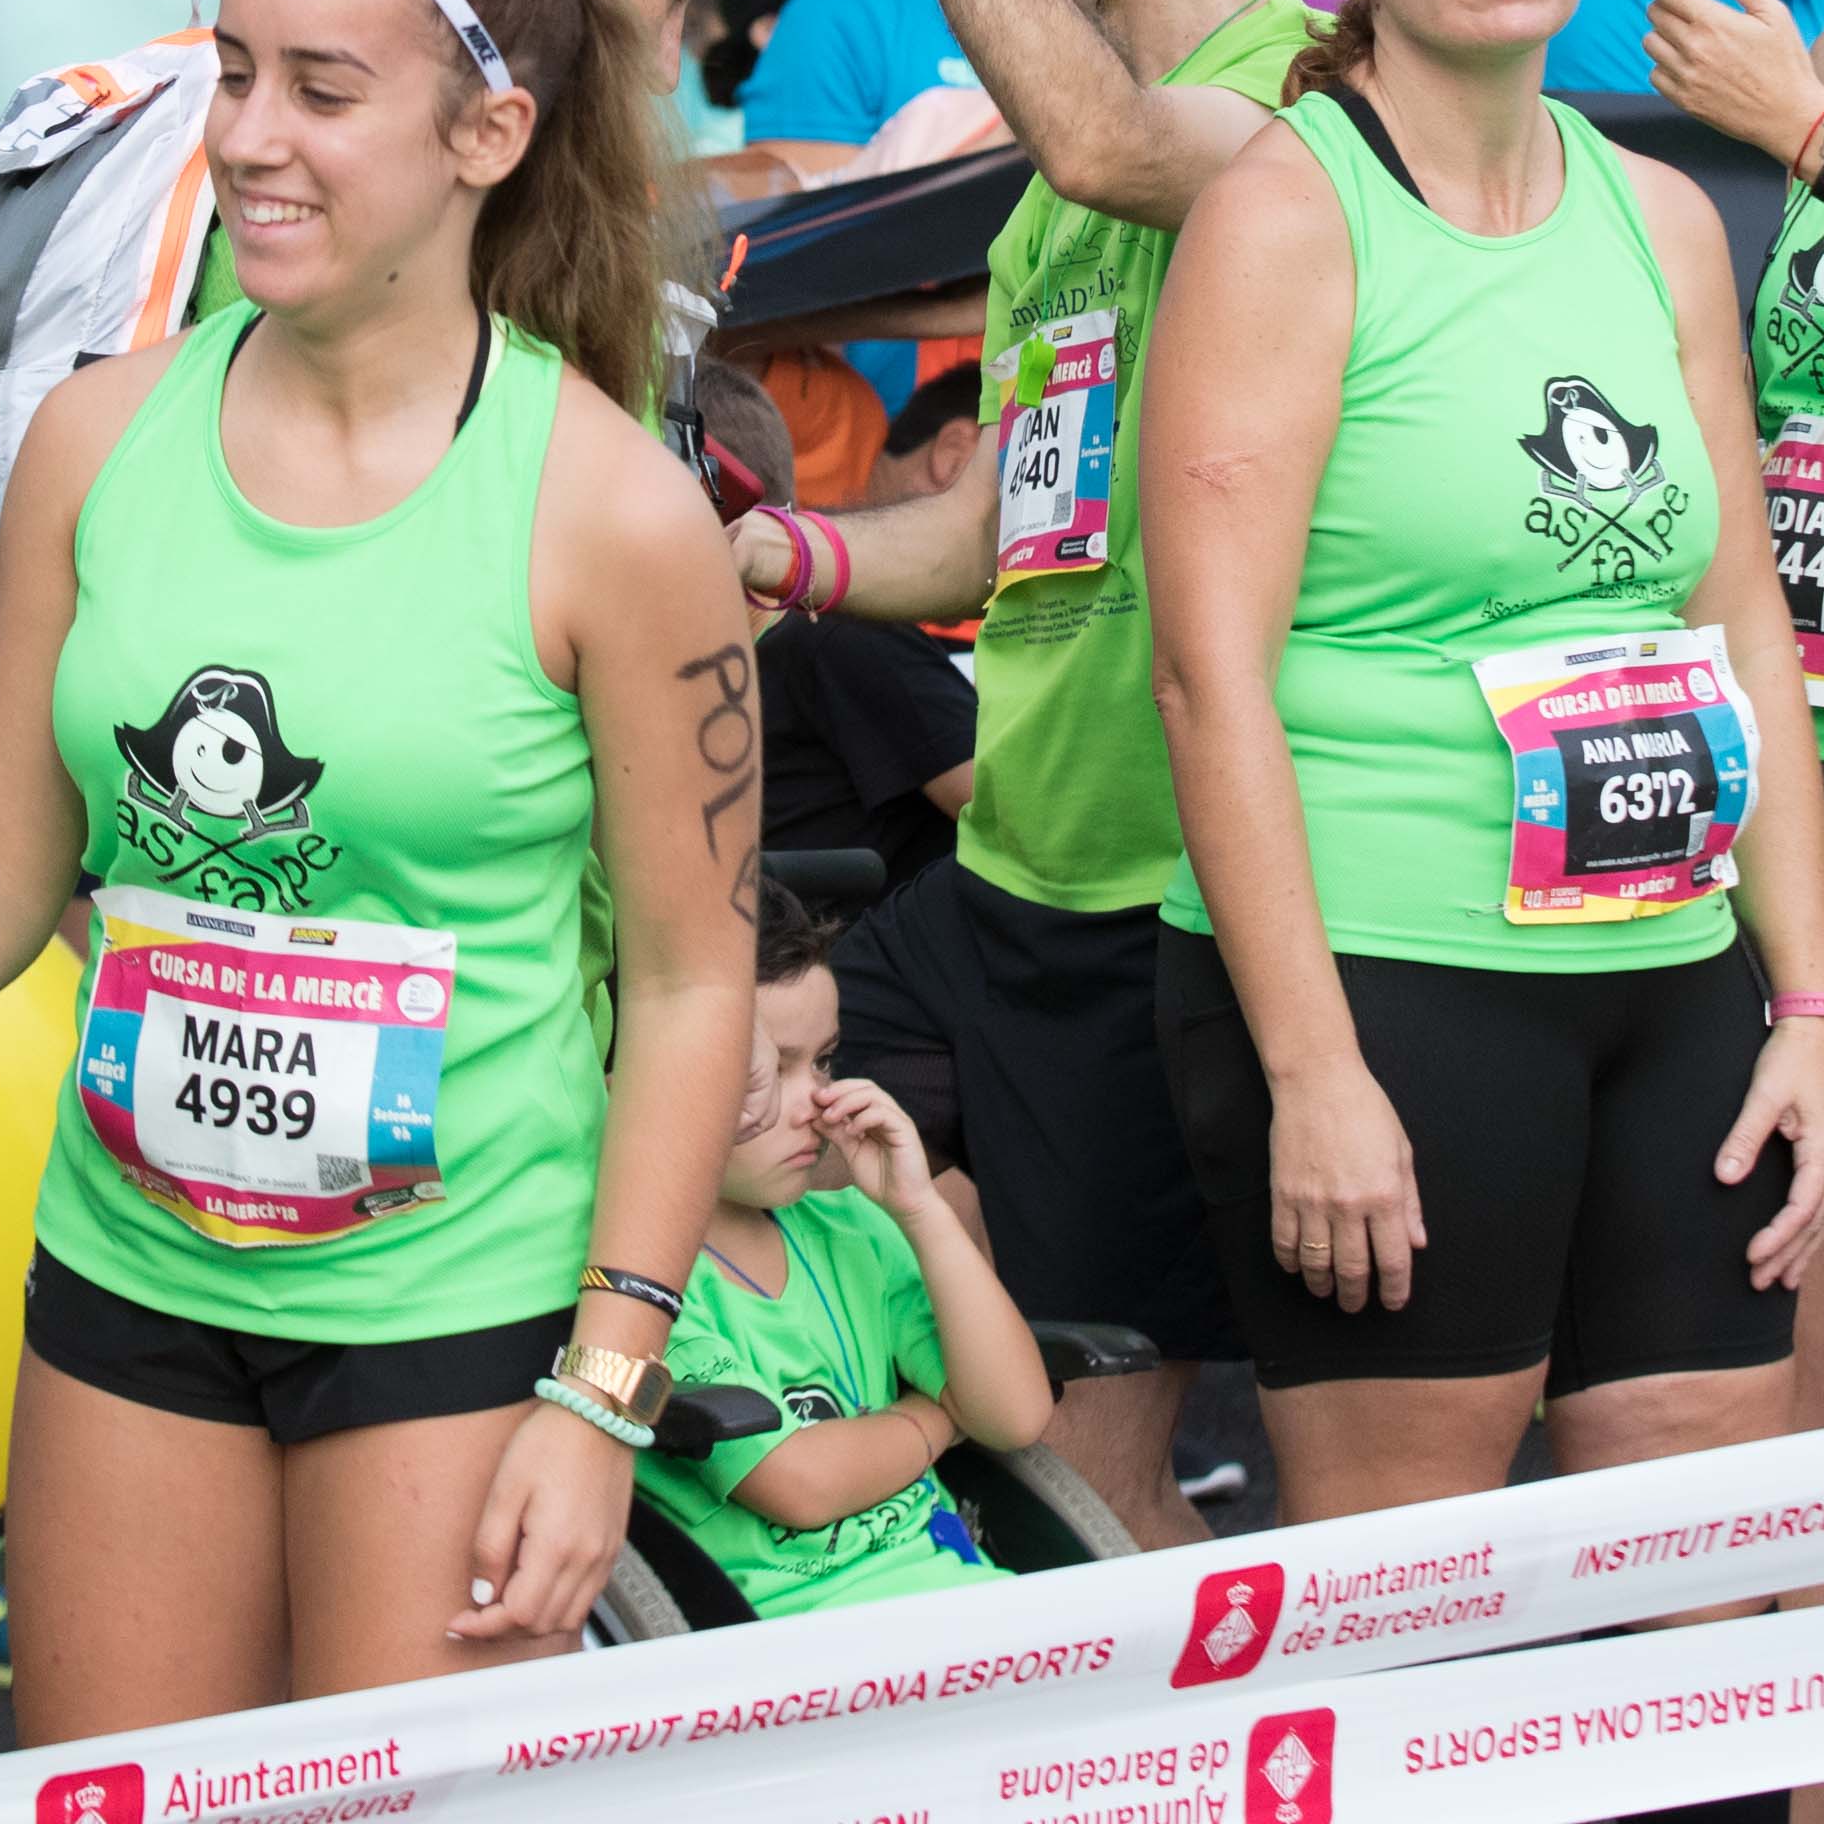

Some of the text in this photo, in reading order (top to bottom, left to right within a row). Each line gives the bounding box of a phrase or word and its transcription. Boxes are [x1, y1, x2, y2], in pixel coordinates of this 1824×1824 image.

[463, 24, 498, 65] NIKE
[1767, 306, 1808, 356] as
[1052, 353, 1093, 385] MERCÈ
[1019, 404, 1061, 452] JOAN
[1009, 447, 1061, 501] 4940
[1797, 458, 1822, 481] LA
[1525, 484, 1689, 586] as fa pe
[1538, 690, 1605, 719] CURSA
[1605, 685, 1632, 709] DE
[1645, 676, 1688, 704] MERCÈ
[1582, 737, 1633, 764] ANA
[1599, 768, 1696, 824] 6372
[116, 798, 189, 867] as
[1523, 889, 1543, 908] 40
[149, 950, 384, 1011] CURSA DE LA MERCÈ
[101, 1043, 116, 1062] LA
[182, 1014, 318, 1077] MARA
[175, 1073, 317, 1140] 4939
[206, 1196, 225, 1216] LA
[1295, 1541, 1495, 1617] Ajuntament
[1572, 1520, 1724, 1580] INSTITUT
[1281, 1590, 1506, 1656] de Barcelona
[498, 1637, 1116, 1775] INSTITUT BARCELONA ESPORTS
[1574, 1680, 1776, 1749] BARCELONA
[999, 1738, 1230, 1802] de Barcelona
[1404, 1715, 1562, 1774] ESPORTS
[163, 1738, 401, 1823] Ajuntament
